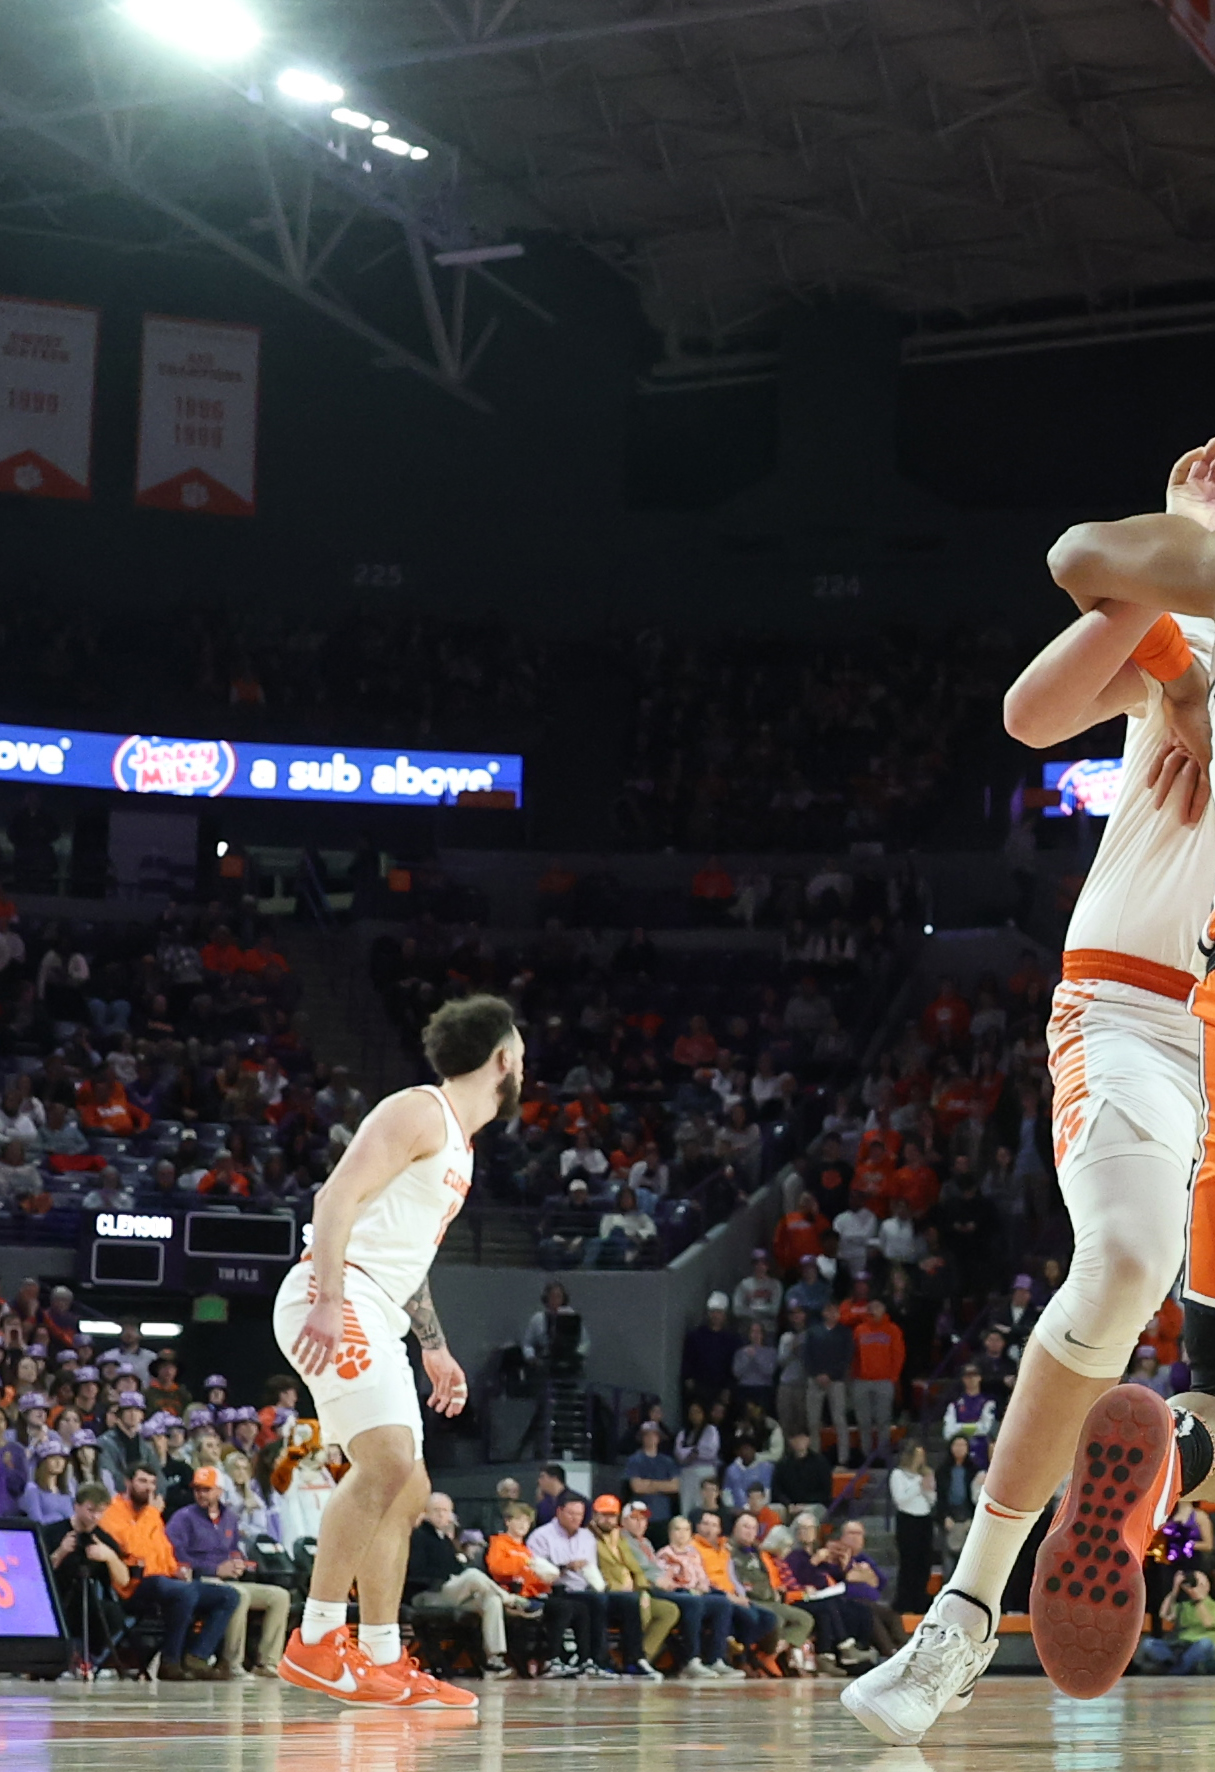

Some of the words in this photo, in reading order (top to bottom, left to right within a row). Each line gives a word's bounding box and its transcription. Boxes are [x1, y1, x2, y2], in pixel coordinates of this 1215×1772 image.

[250, 759, 277, 789] a
[288, 753, 362, 793] sub
[96, 1213, 174, 1239] CLEMSON
